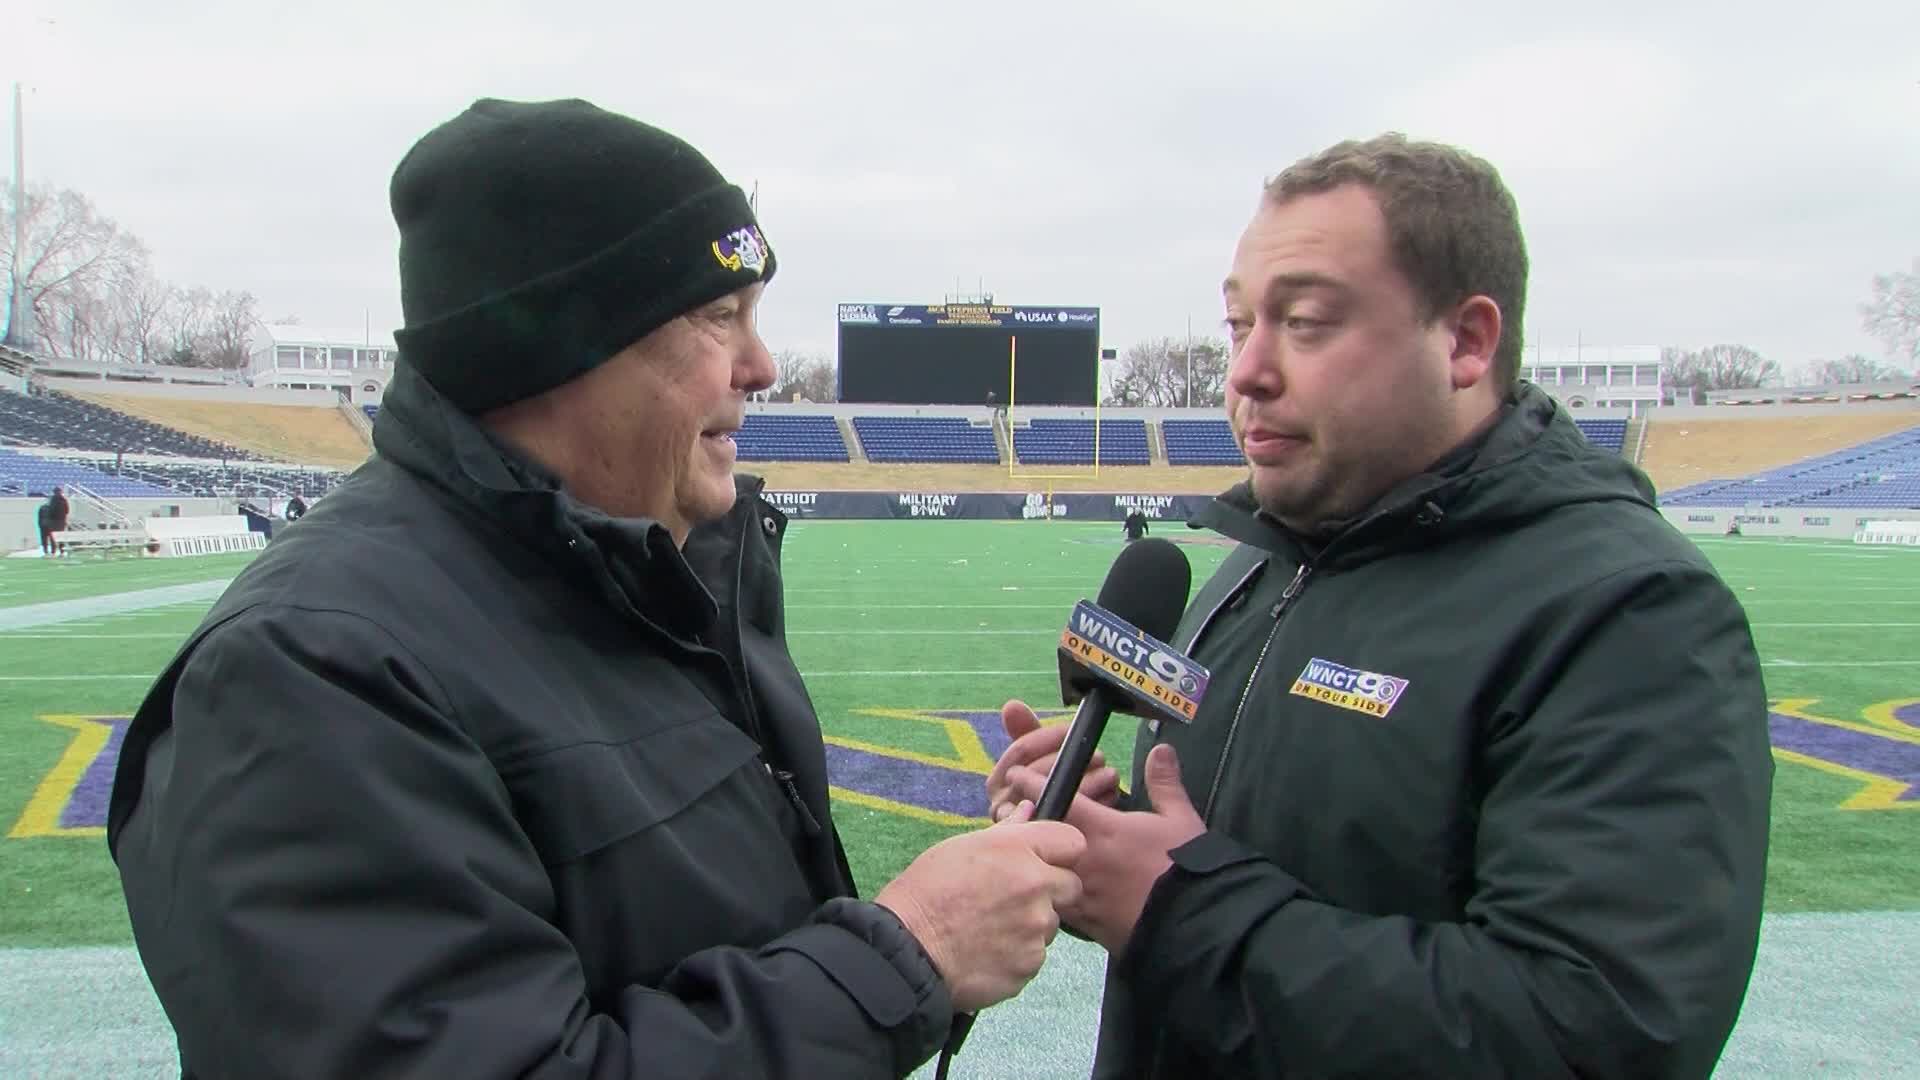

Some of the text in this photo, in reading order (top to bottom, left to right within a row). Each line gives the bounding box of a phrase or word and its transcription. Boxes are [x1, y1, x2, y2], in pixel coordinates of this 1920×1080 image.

[840, 305, 865, 313] NAVY
[990, 306, 1013, 314] FIELD
[1028, 313, 1054, 322] USAA
[900, 494, 957, 505] MILITARY
[1026, 494, 1043, 506] GO
[1115, 495, 1173, 507] MILITARY
[1068, 637, 1192, 714] ON YOUR SIDE
[1296, 682, 1386, 714] ON YOUR SIDE
